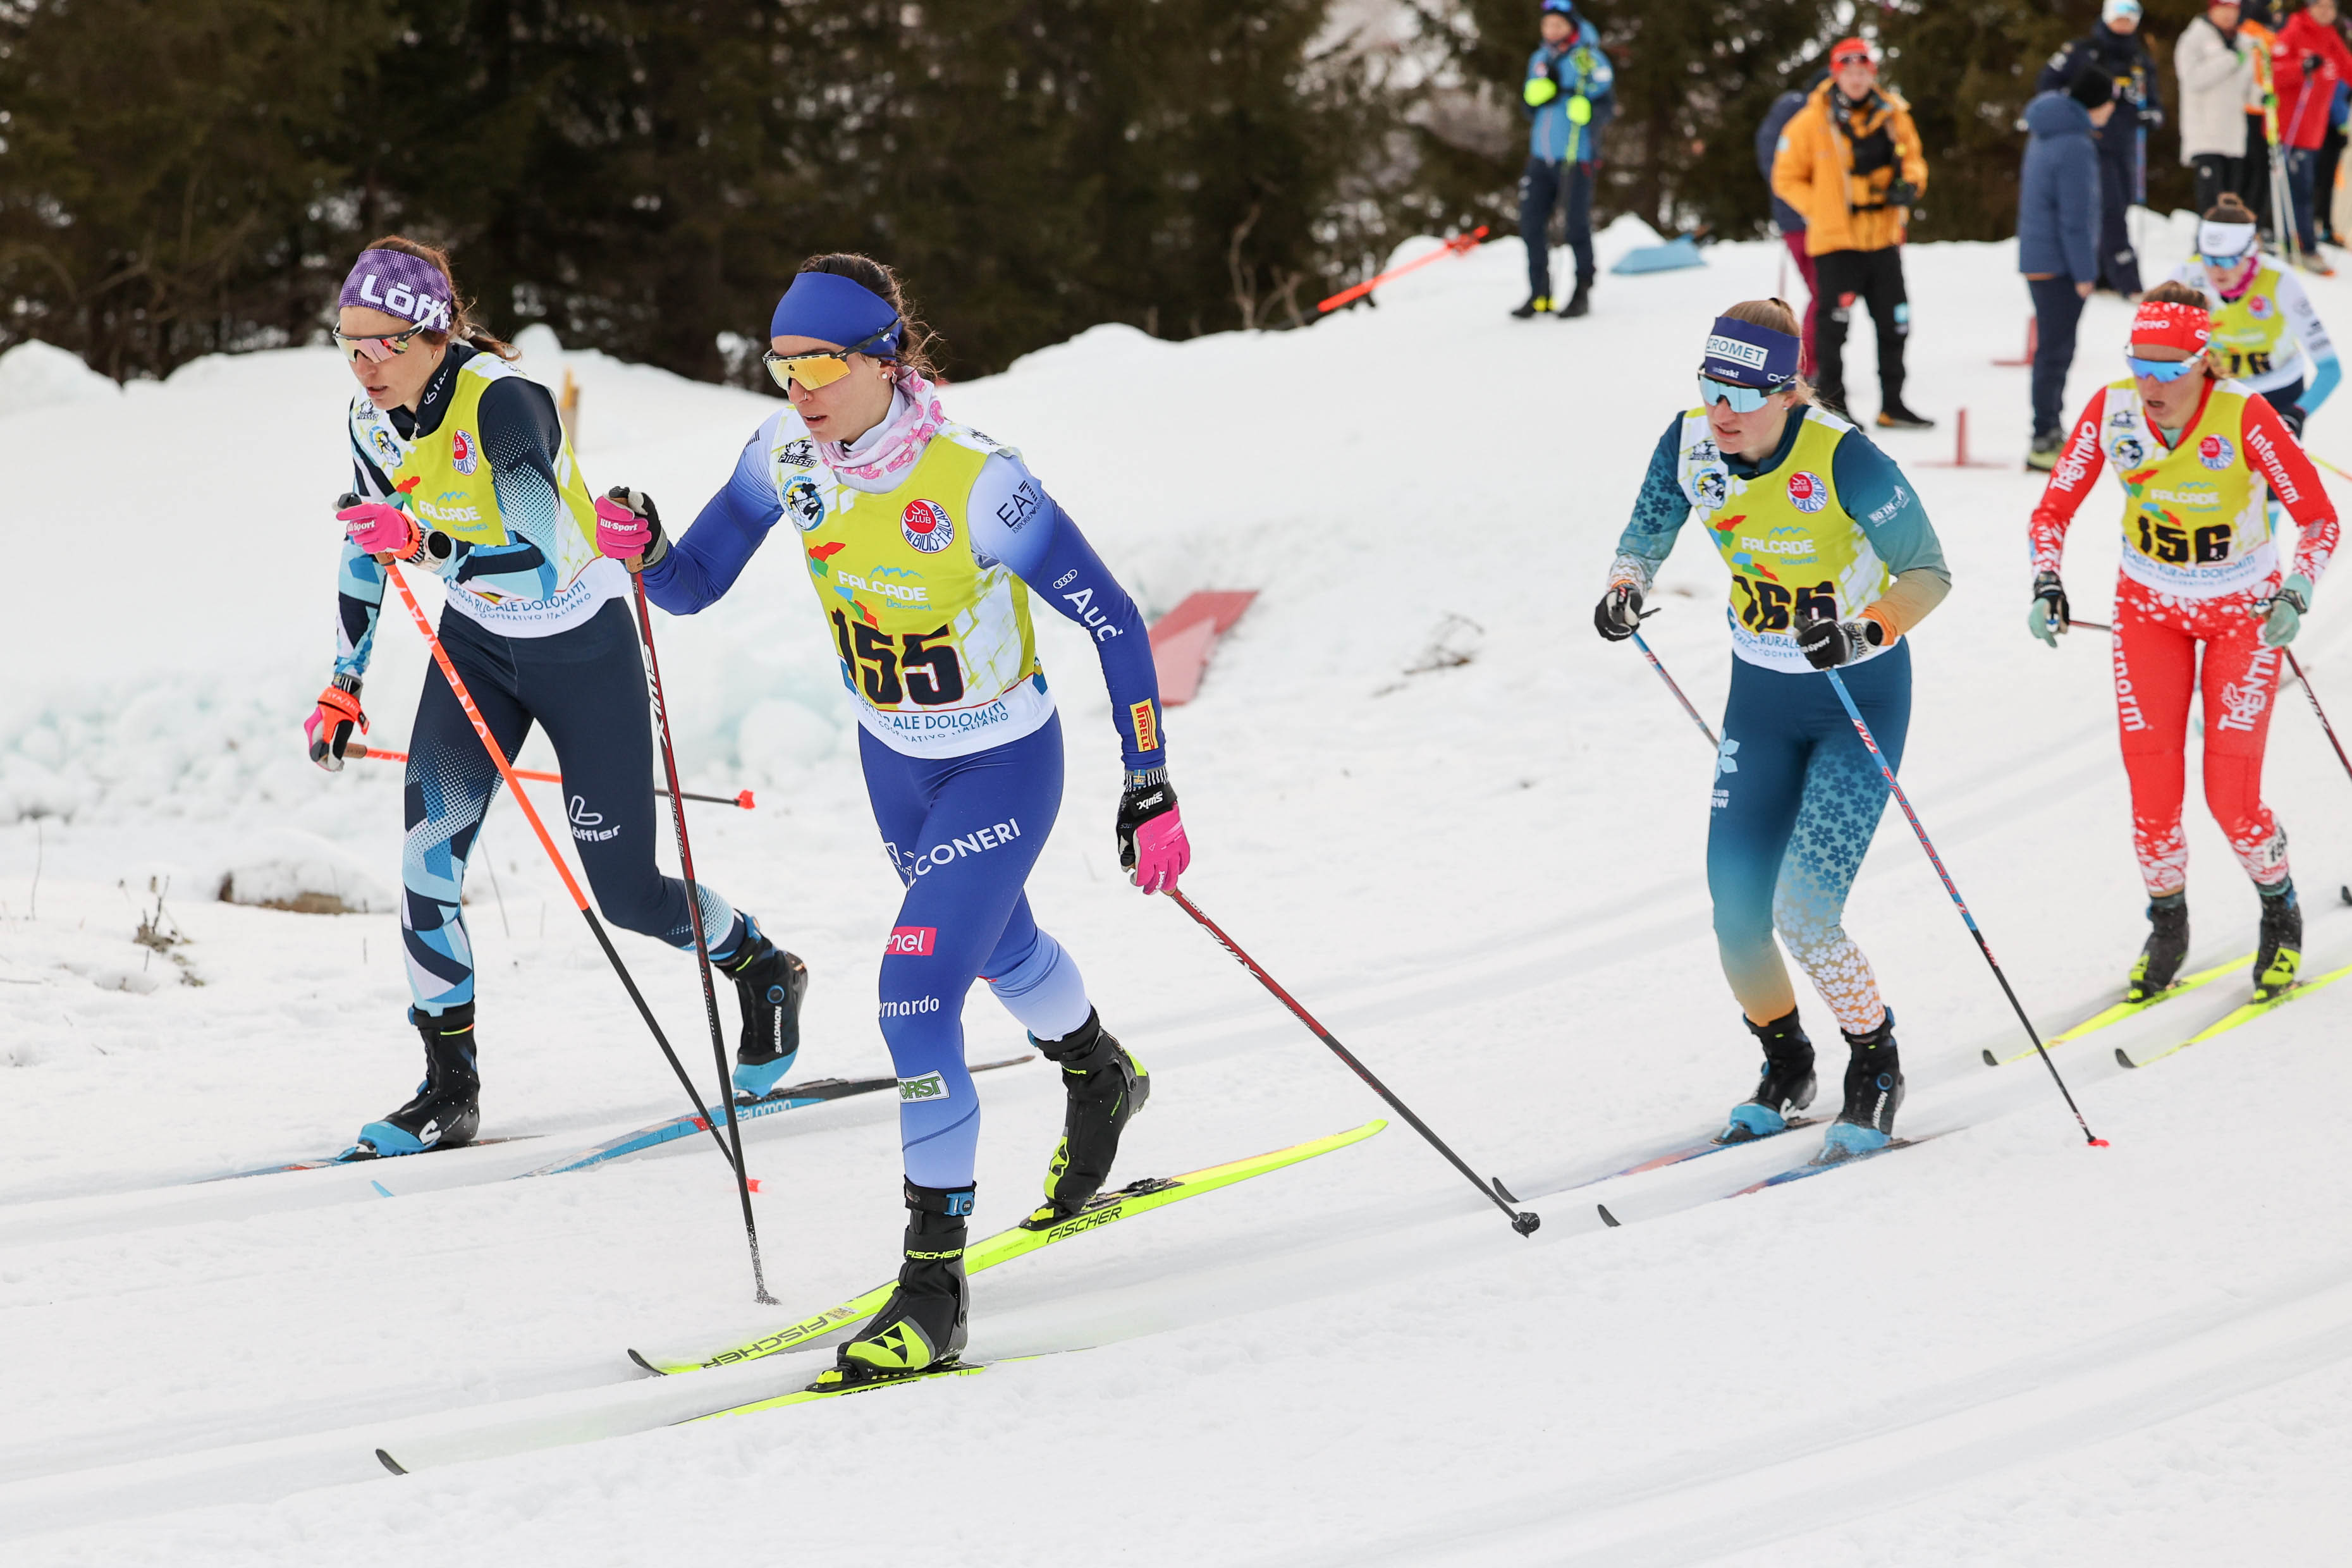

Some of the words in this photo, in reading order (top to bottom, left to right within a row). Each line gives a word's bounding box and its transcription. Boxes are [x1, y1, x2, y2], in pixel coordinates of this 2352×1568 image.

[2246, 424, 2300, 505] Internorm
[419, 501, 482, 522] FALCADE
[912, 503, 929, 517] SCI
[2150, 489, 2220, 505] FALCADE
[1741, 536, 1816, 555] FALCADE
[2138, 517, 2232, 565] 156
[523, 580, 586, 612] DOLOMITI
[837, 570, 929, 601] FALCADE
[831, 608, 965, 706] 155
[926, 701, 1007, 730] DOLOMITI
[572, 824, 620, 842] öffler
[773, 1005, 783, 1055] SALOMON
[1046, 1207, 1122, 1243] FISCHER
[905, 1248, 962, 1259] FISCHER
